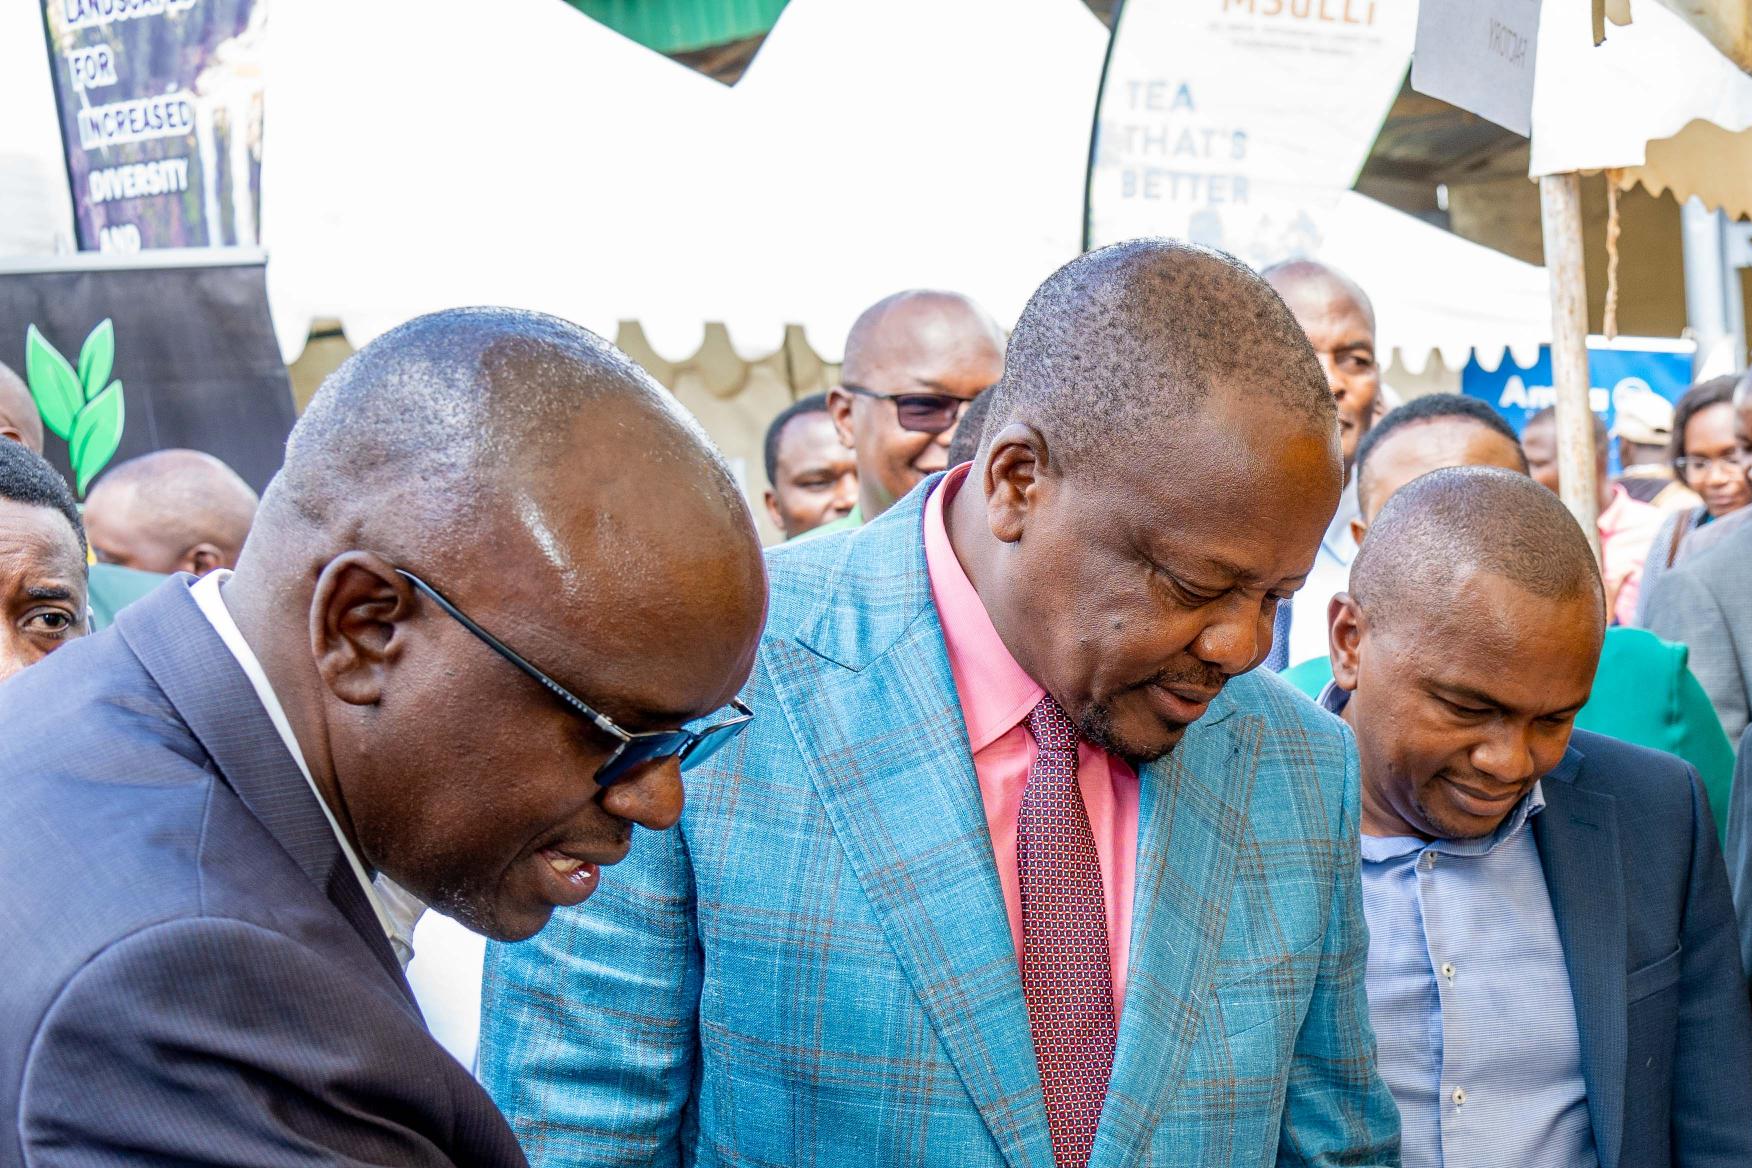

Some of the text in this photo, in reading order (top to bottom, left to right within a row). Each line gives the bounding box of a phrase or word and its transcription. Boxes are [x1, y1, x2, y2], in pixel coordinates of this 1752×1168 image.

[74, 51, 110, 81] FOR
[1125, 79, 1196, 111] TEA
[1122, 123, 1248, 160] THAT'S
[89, 157, 189, 203] DIVERSITY
[1121, 162, 1249, 205] BETTER
[100, 223, 141, 252] AND
